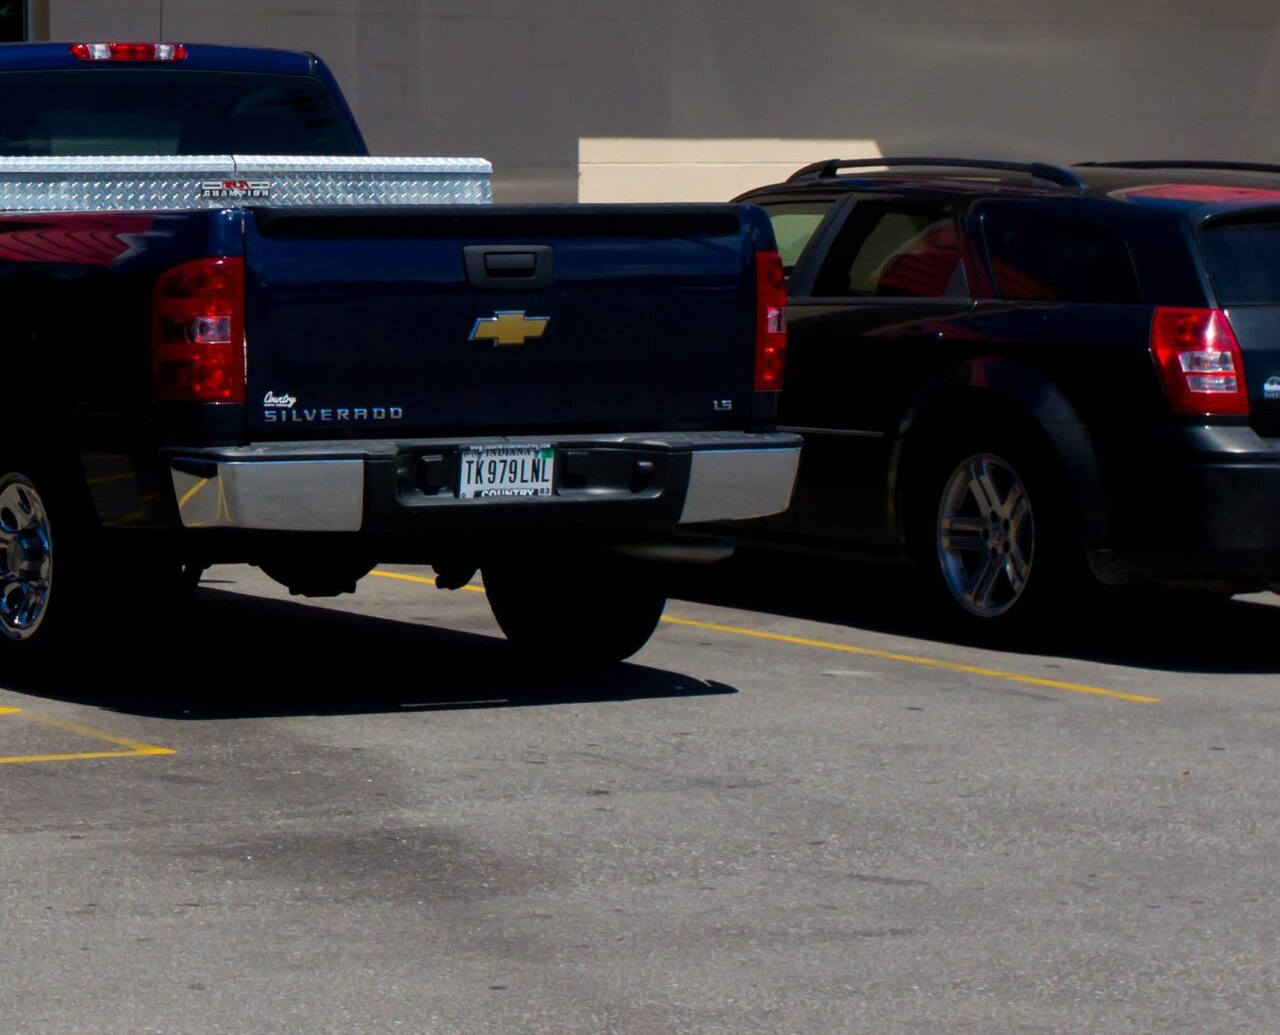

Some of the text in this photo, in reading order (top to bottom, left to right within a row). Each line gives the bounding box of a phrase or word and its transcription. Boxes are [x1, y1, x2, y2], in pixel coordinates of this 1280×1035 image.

[263, 390, 297, 408] Country
[263, 407, 403, 423] SILVERADO
[465, 458, 550, 485] TK979LNL
